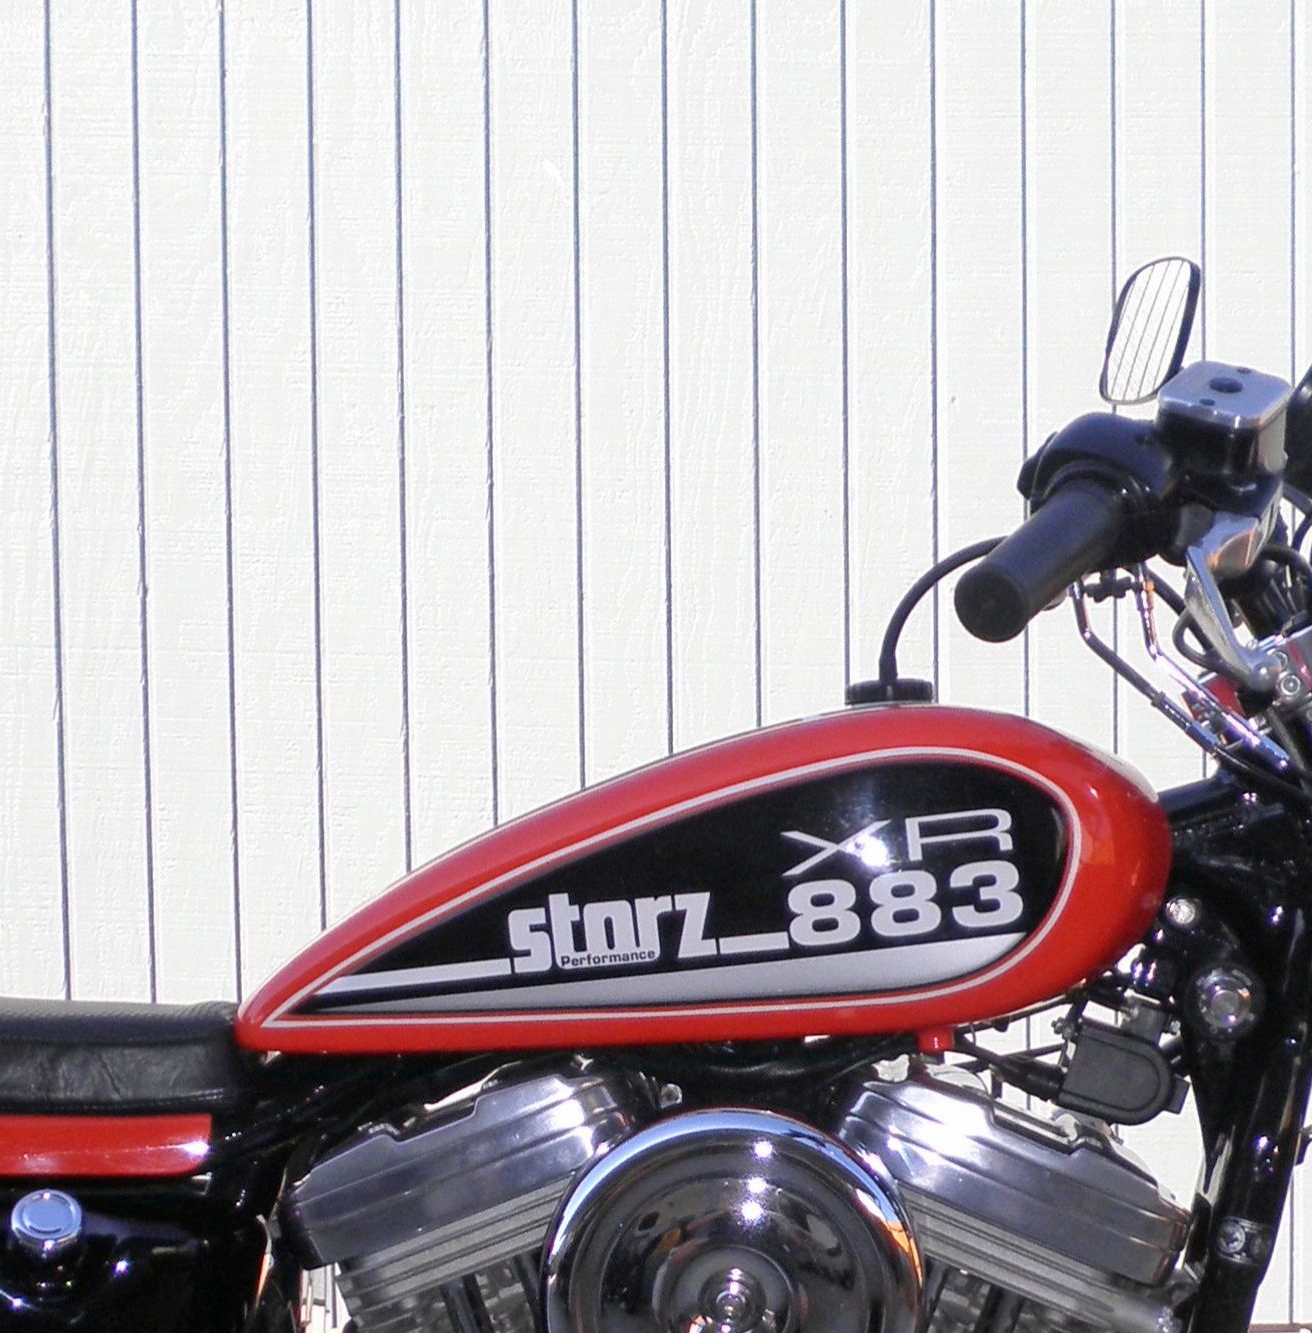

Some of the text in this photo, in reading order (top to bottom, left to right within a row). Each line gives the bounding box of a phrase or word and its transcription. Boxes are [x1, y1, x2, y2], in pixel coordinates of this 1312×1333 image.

[780, 808, 1014, 877] XR
[507, 891, 718, 974] storz
[787, 860, 1025, 946] 883
[560, 949, 656, 967] Performance
